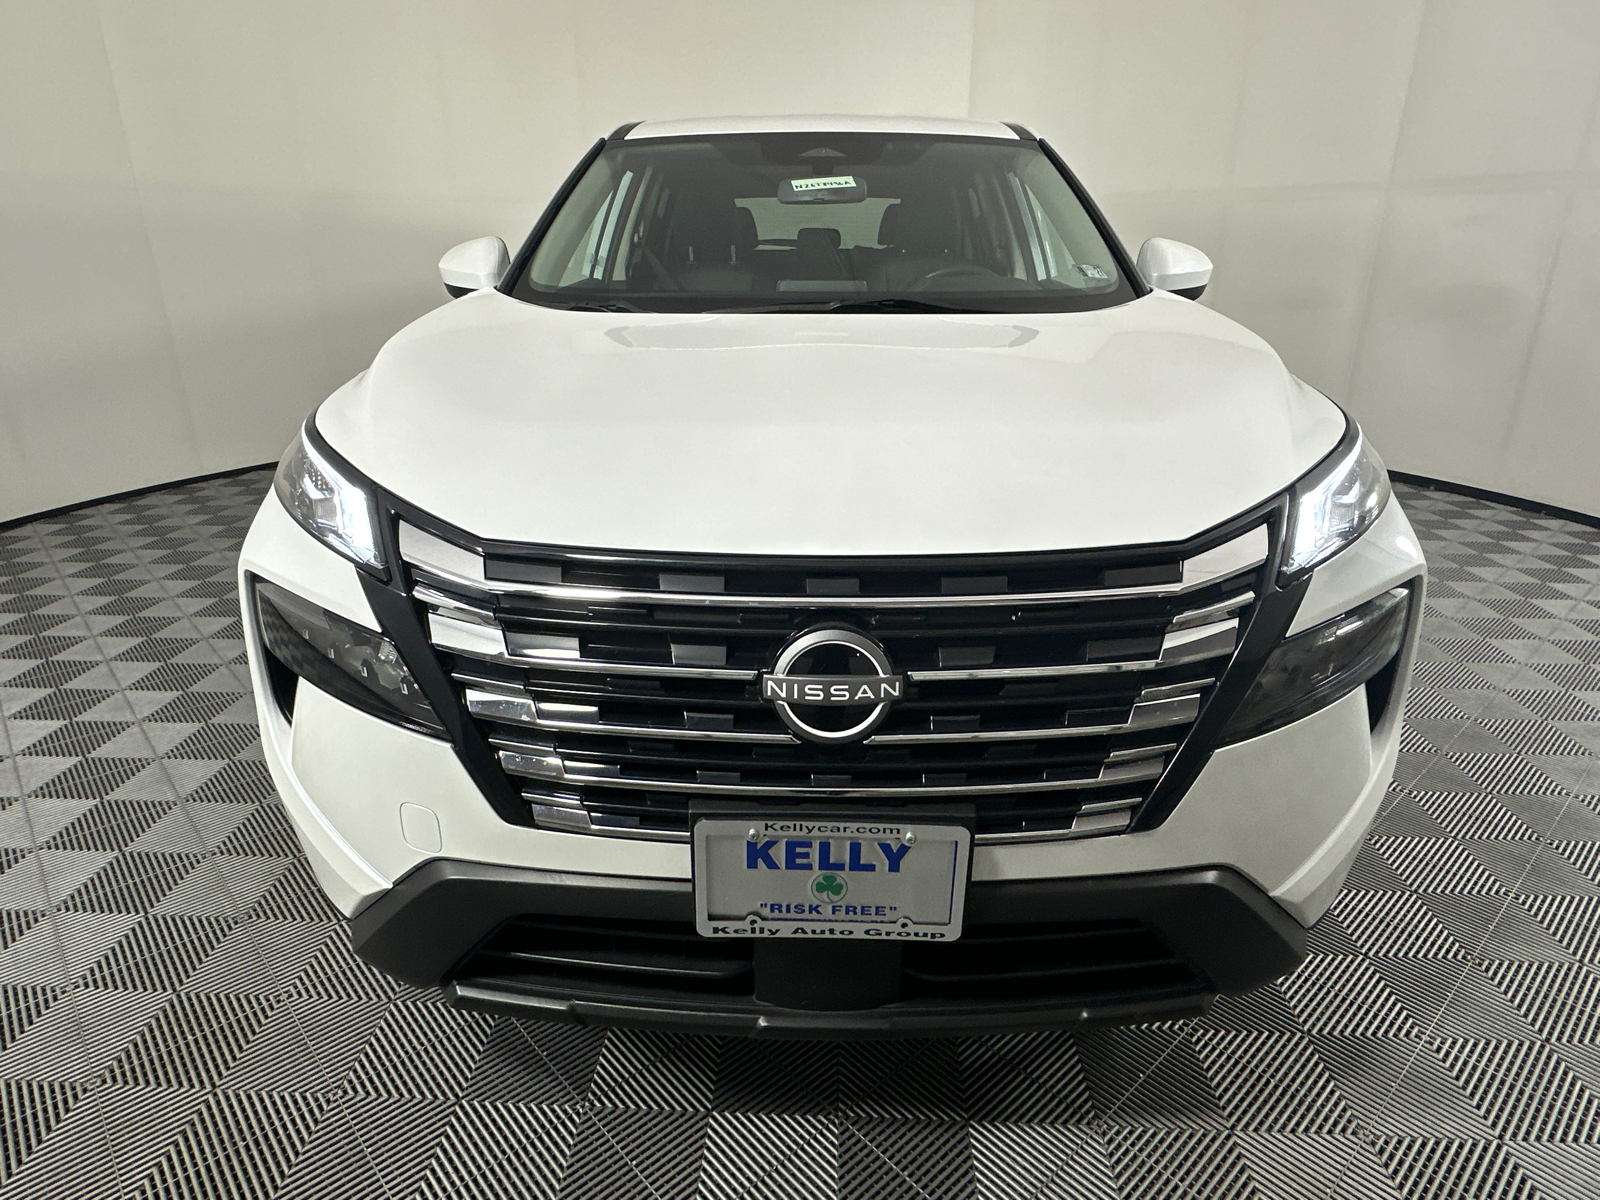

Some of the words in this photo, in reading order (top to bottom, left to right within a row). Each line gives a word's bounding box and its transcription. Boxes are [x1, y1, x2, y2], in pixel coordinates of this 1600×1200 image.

[767, 680, 899, 701] NISSAN
[764, 822, 901, 835] Kellycar.com
[746, 839, 912, 873] KELLY
[760, 903, 822, 916] "RISK
[832, 904, 897, 916] FREE"
[712, 926, 780, 936] Kelly
[791, 926, 854, 936] Auto
[864, 928, 946, 940] Group
